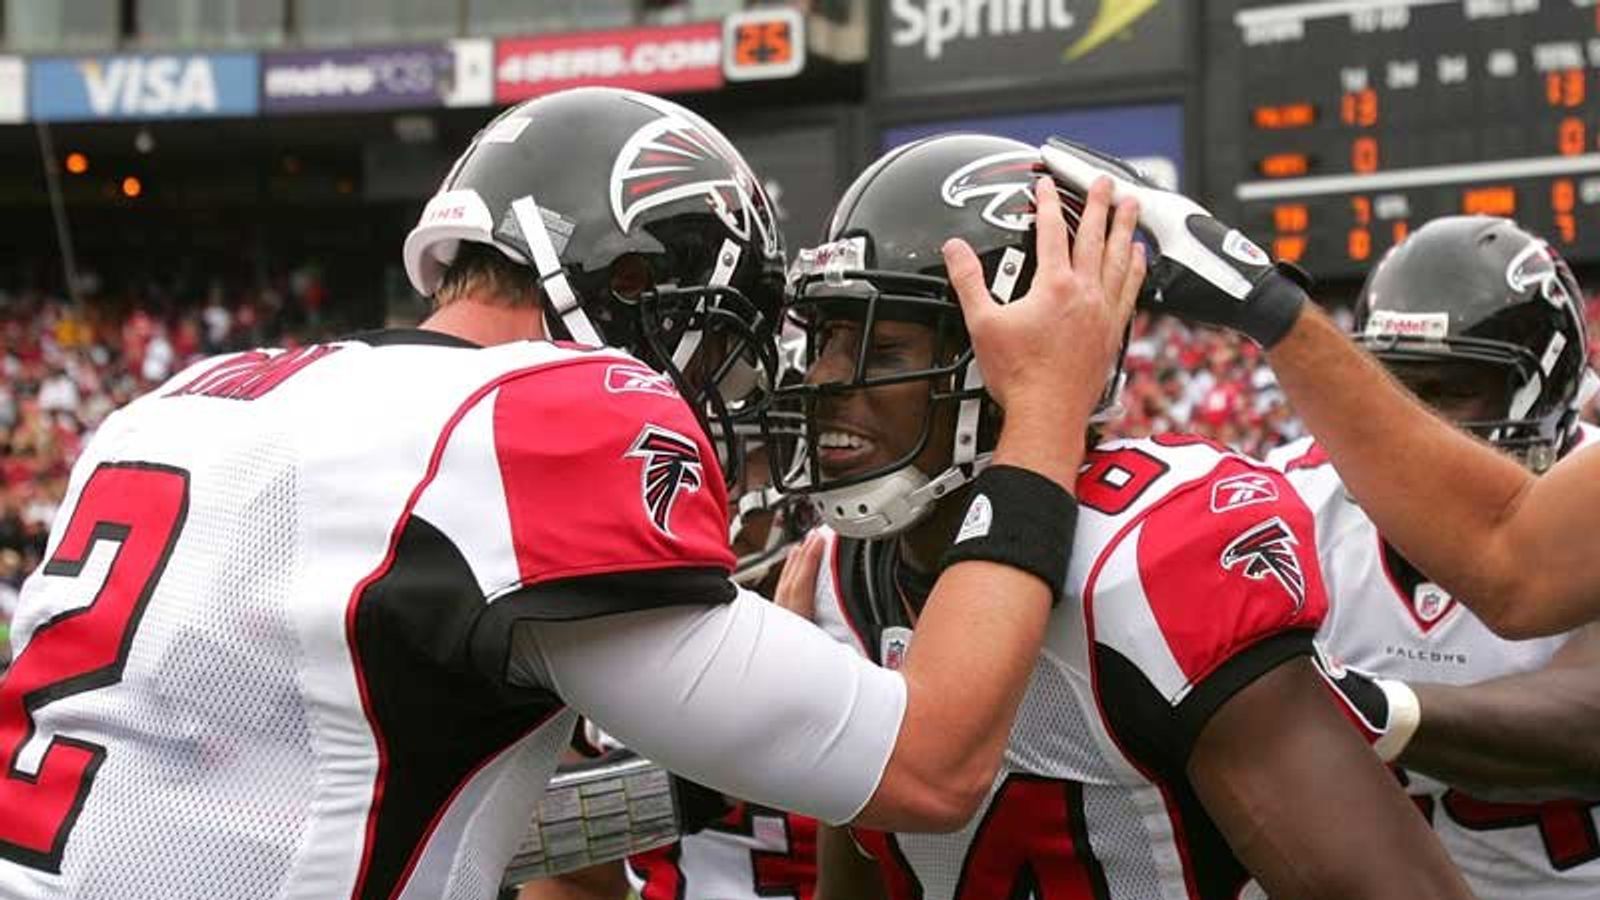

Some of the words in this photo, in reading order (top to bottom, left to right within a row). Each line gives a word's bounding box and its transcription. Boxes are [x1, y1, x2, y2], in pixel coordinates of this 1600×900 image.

[735, 20, 792, 66] 25
[890, 0, 1074, 60] Sprint
[80, 54, 217, 116] VISA
[498, 39, 722, 84] 49ERS.COM
[0, 461, 190, 875] 2
[1386, 646, 1467, 664] FALCONS
